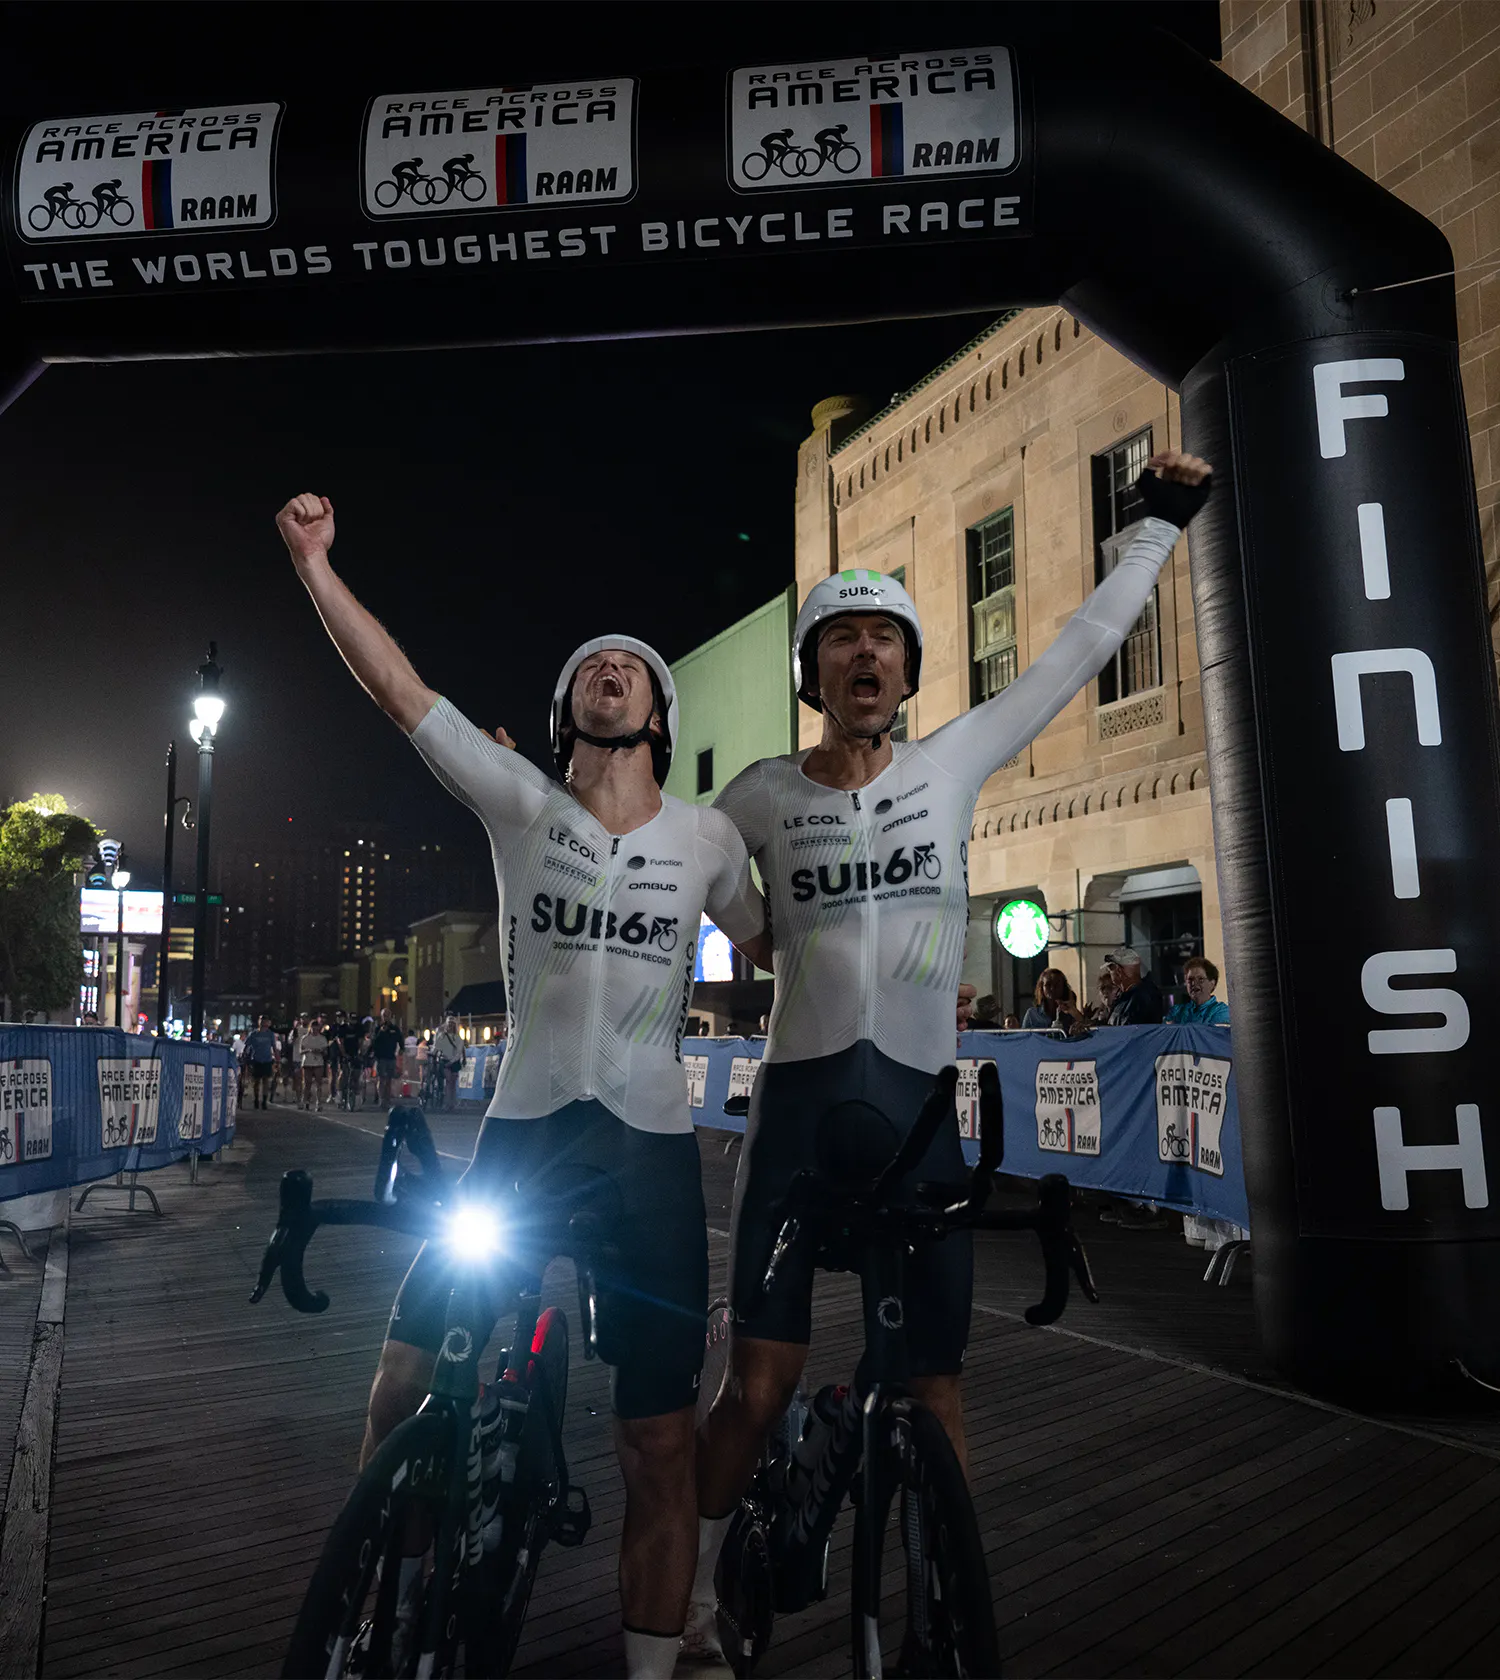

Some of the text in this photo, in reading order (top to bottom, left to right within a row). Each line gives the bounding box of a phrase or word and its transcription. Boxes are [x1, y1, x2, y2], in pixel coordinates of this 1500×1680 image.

[749, 54, 993, 85] RACE ACROSS
[386, 86, 617, 114] RACE ACROSS
[748, 68, 996, 110] AMERICA
[42, 113, 262, 138] RACE ACROSS
[382, 100, 616, 138] AMERICA
[36, 127, 258, 163] AMERICA
[912, 137, 1001, 168] RAAM
[535, 167, 618, 196] RAAM
[181, 194, 257, 222] RAAM
[23, 196, 1021, 290] THE WORLDS TOUGHEST BICYCLE RACE
[896, 782, 929, 803] Function
[1313, 358, 1490, 1211] FINISH
[784, 815, 846, 830] LE COL
[548, 827, 599, 865] LE COL
[650, 858, 683, 868] Function
[791, 847, 912, 903] SUB6
[821, 886, 941, 910] 3000 MILE WORLD RECORD
[531, 892, 648, 945] SUB6
[552, 941, 672, 966] 3000 MILE WORLD RECORD
[10, 1072, 48, 1086] ACROSS
[101, 1069, 159, 1082] RACE ACROSS
[1039, 1072, 1094, 1084] RACE ACROSS
[0, 1087, 48, 1111] ERICA
[102, 1083, 159, 1102] AMERICA
[1040, 1086, 1096, 1105] AMERICA
[26, 1138, 49, 1156] RAAM
[1200, 1146, 1220, 1170] RAAM
